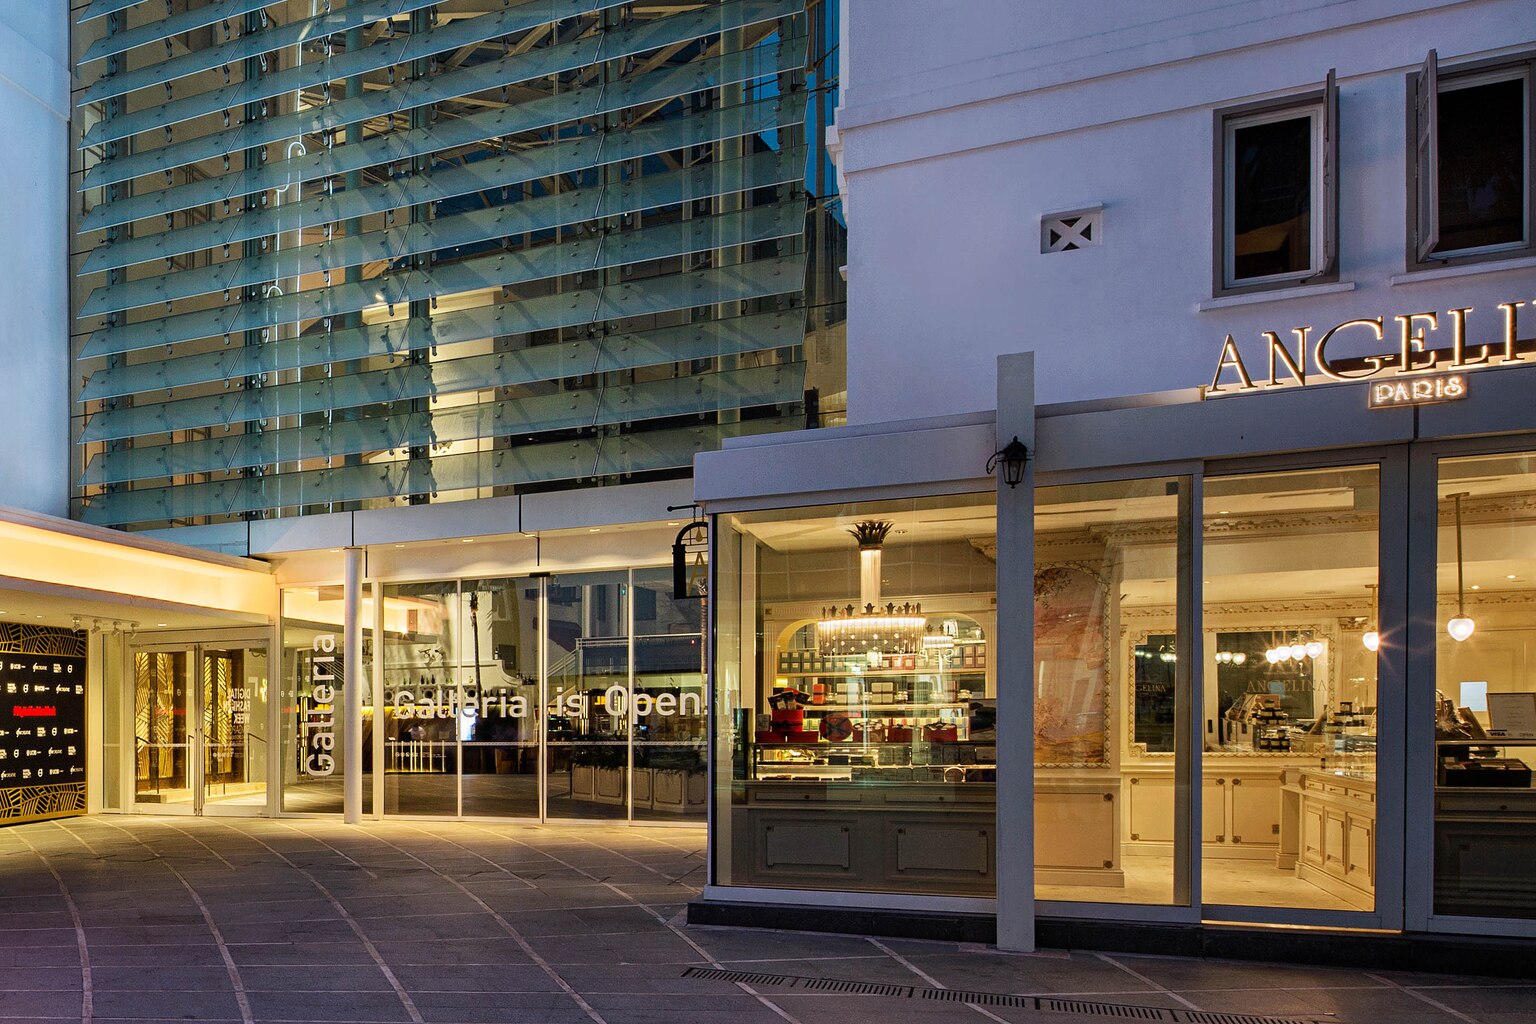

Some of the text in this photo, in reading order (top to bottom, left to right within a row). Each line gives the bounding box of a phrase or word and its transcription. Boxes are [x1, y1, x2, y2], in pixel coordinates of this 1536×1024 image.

[1205, 299, 1536, 393] ANGELI
[1374, 376, 1464, 403] PARIS
[1247, 679, 1327, 692] ANGELINA
[306, 634, 335, 777] Galleria
[394, 688, 528, 719] Galleria
[556, 687, 583, 717] is
